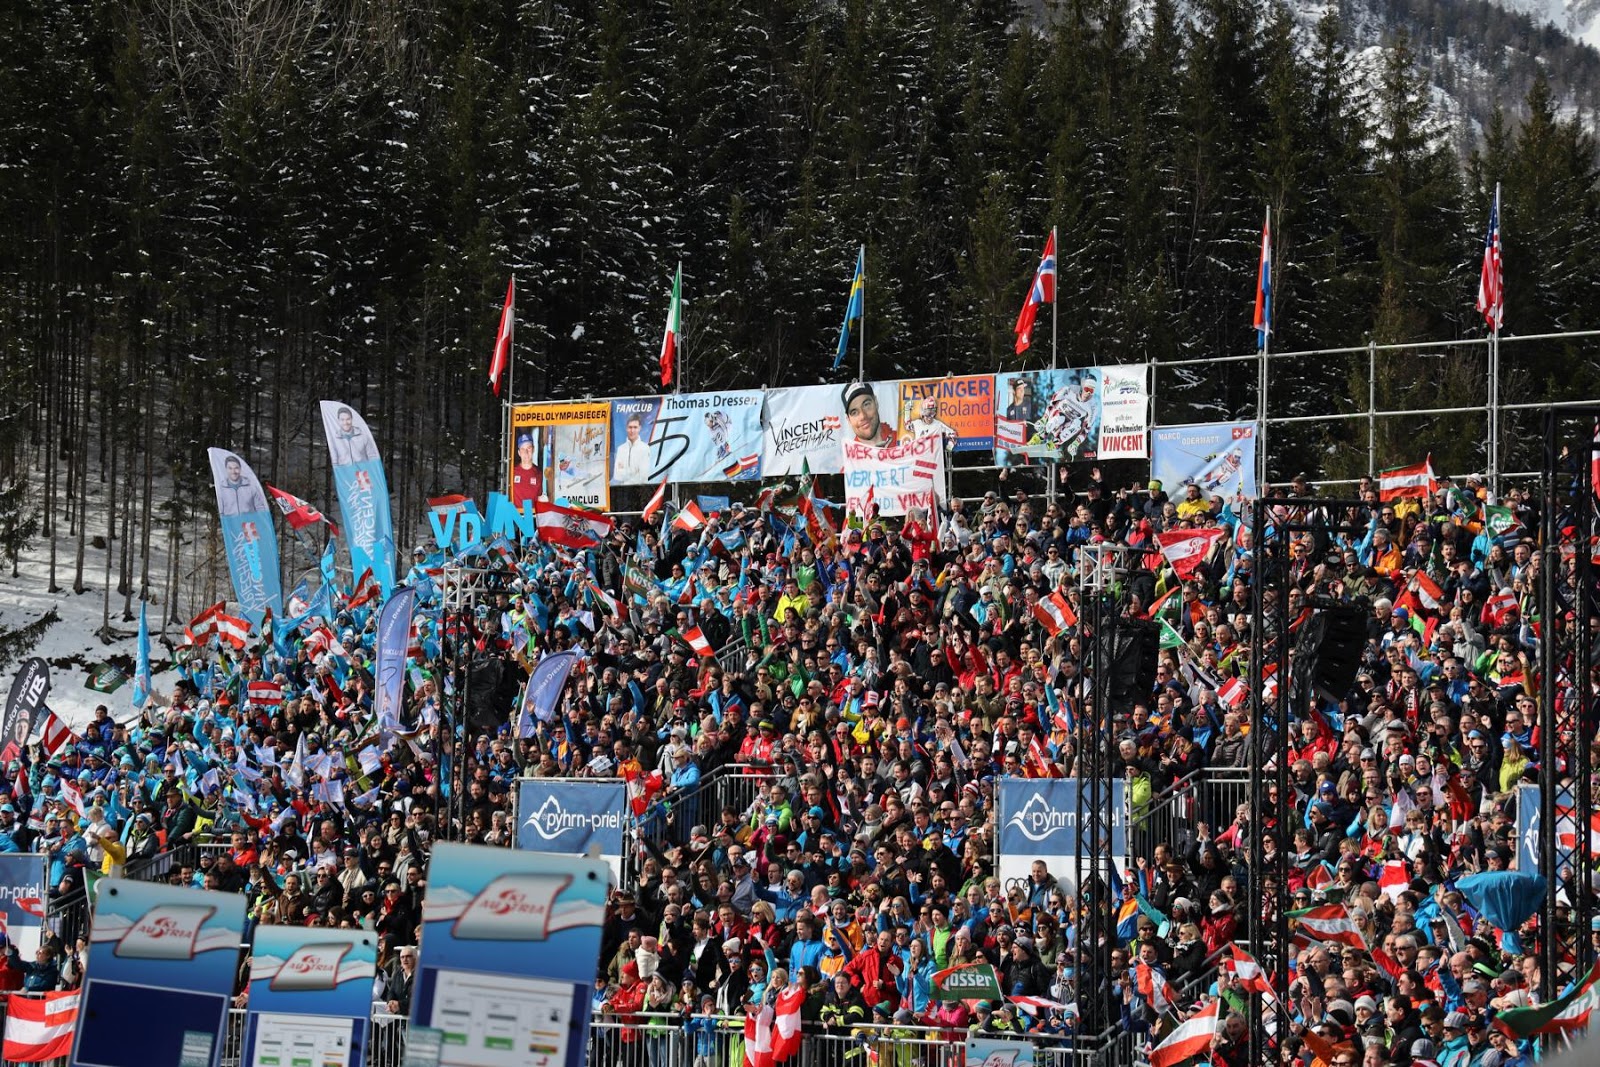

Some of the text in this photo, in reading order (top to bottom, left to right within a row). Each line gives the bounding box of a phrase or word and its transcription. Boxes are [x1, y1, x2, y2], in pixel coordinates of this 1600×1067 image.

[902, 380, 990, 401] LEITINGER
[616, 403, 653, 414] FANCLUB
[666, 395, 758, 410] Thomas Dressen
[940, 398, 991, 417] Roland
[515, 410, 607, 422] DOPPELOLYMPIASIEGER
[769, 417, 827, 446] VINCENT
[1158, 431, 1219, 445] MARCO ODERMATT
[775, 428, 836, 456] KRIECHMAYR
[1102, 434, 1144, 452] VINCENT
[547, 658, 568, 681] Dressen
[547, 808, 620, 832] pyhrn-priel
